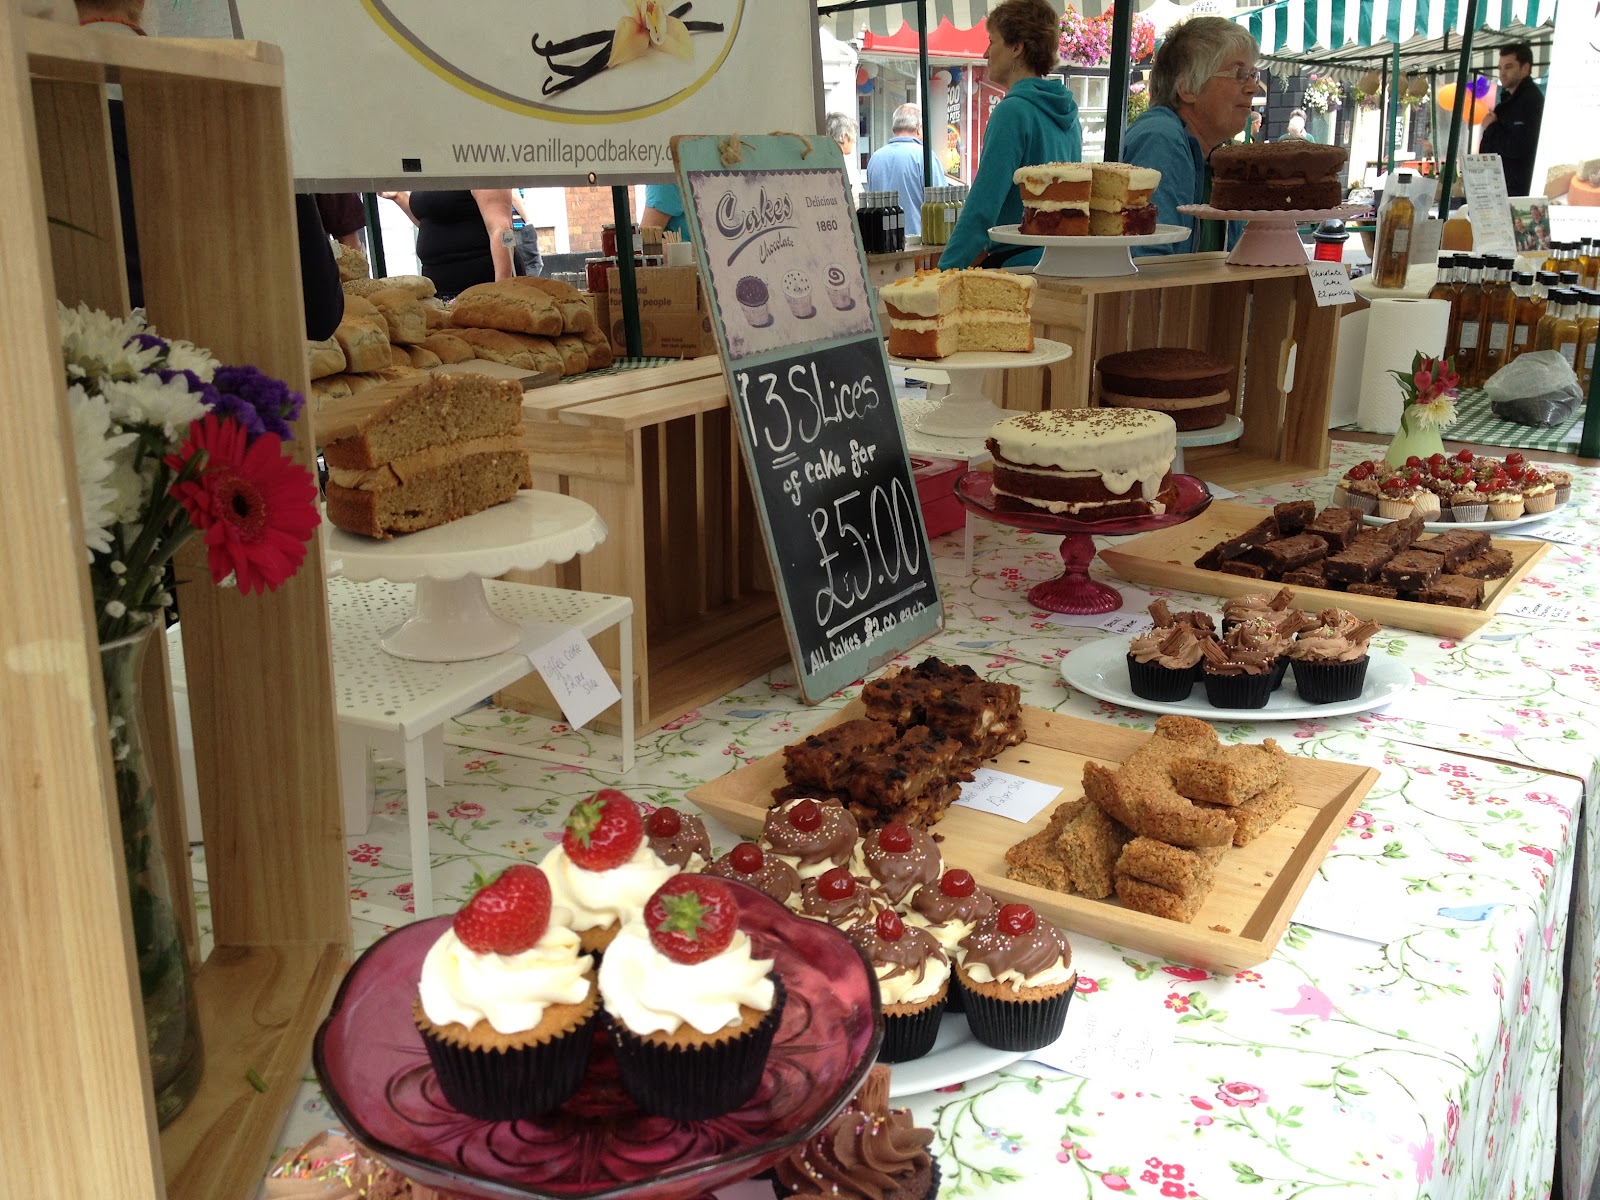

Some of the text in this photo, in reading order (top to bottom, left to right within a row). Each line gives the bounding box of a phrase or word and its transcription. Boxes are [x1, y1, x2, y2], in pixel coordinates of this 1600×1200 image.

[716, 186, 794, 240] Cakes
[805, 195, 838, 208] Delicious
[816, 220, 838, 232] 1860
[758, 232, 794, 264] Chocolate
[643, 298, 672, 308] people
[782, 470, 802, 506] of
[849, 439, 876, 479] for
[811, 477, 920, 626] £5.00
[900, 600, 928, 623] each
[543, 656, 566, 680] Coffee
